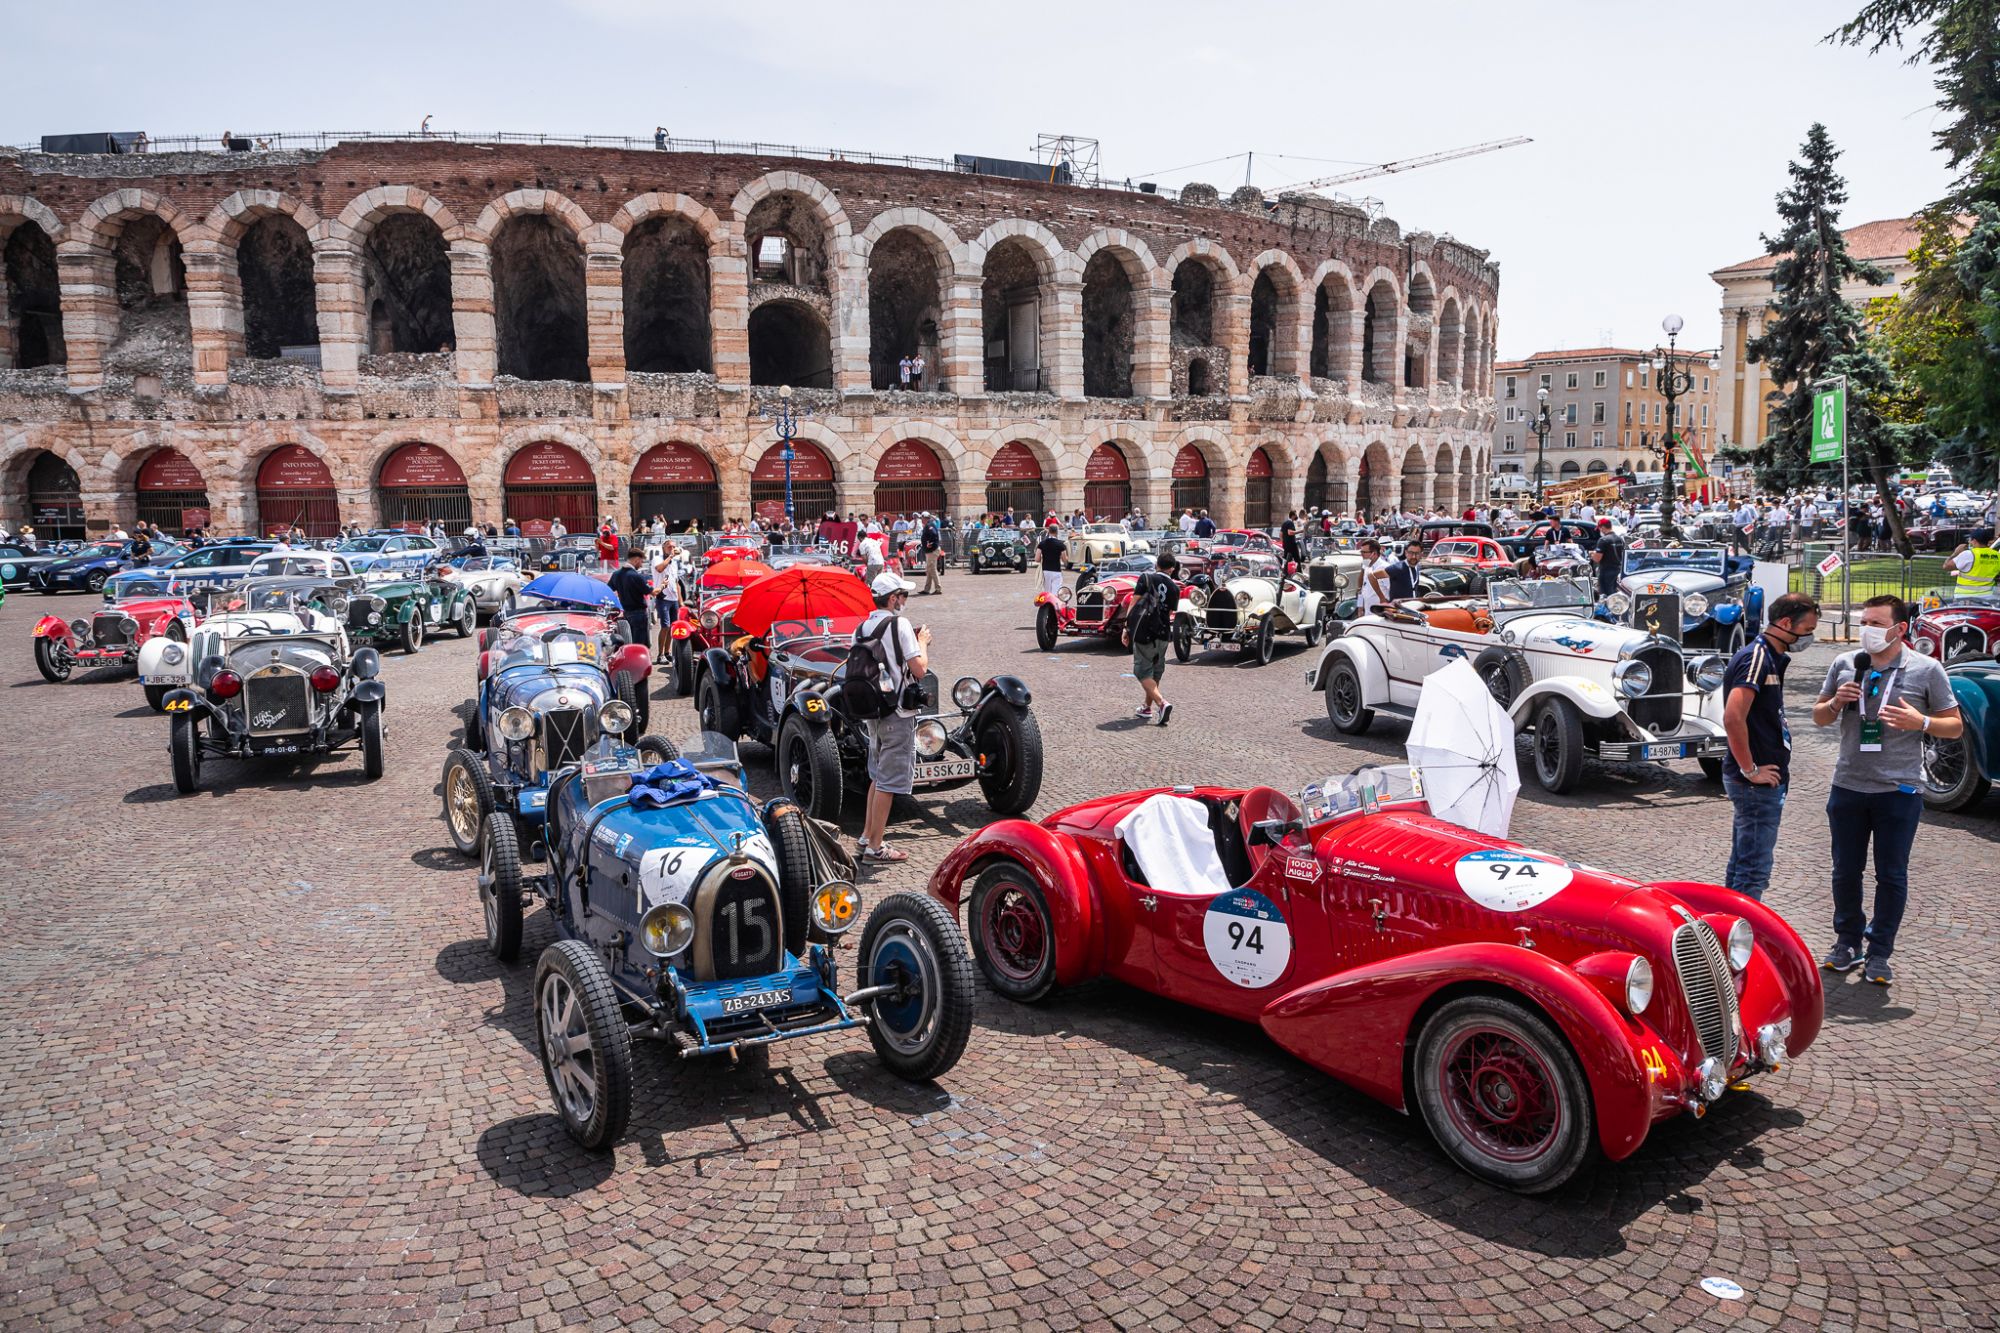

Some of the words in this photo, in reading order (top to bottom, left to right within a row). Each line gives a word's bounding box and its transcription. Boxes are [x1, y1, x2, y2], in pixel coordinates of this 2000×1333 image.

[390, 559, 425, 568] POLIZIA
[1923, 597, 1940, 609] 75
[672, 627, 687, 636] 43
[576, 641, 596, 657] 28
[78, 657, 92, 666] MV
[94, 657, 120, 666] 3508
[775, 681, 783, 697] 51
[164, 699, 190, 711] 44
[806, 698, 827, 712] 51
[264, 745, 297, 754] PM-01-65
[914, 767, 925, 779] SL
[933, 764, 954, 777] SSK
[956, 763, 970, 775] 29
[659, 850, 686, 879] 16
[1291, 859, 1313, 870] 1000
[734, 869, 754, 878] BUGATTI
[1288, 867, 1314, 879] MIGLIA
[1489, 864, 1539, 881] 94
[818, 888, 853, 921] 16
[720, 897, 772, 966] 15
[1228, 921, 1265, 955] 94
[1641, 1046, 1668, 1083] 94
